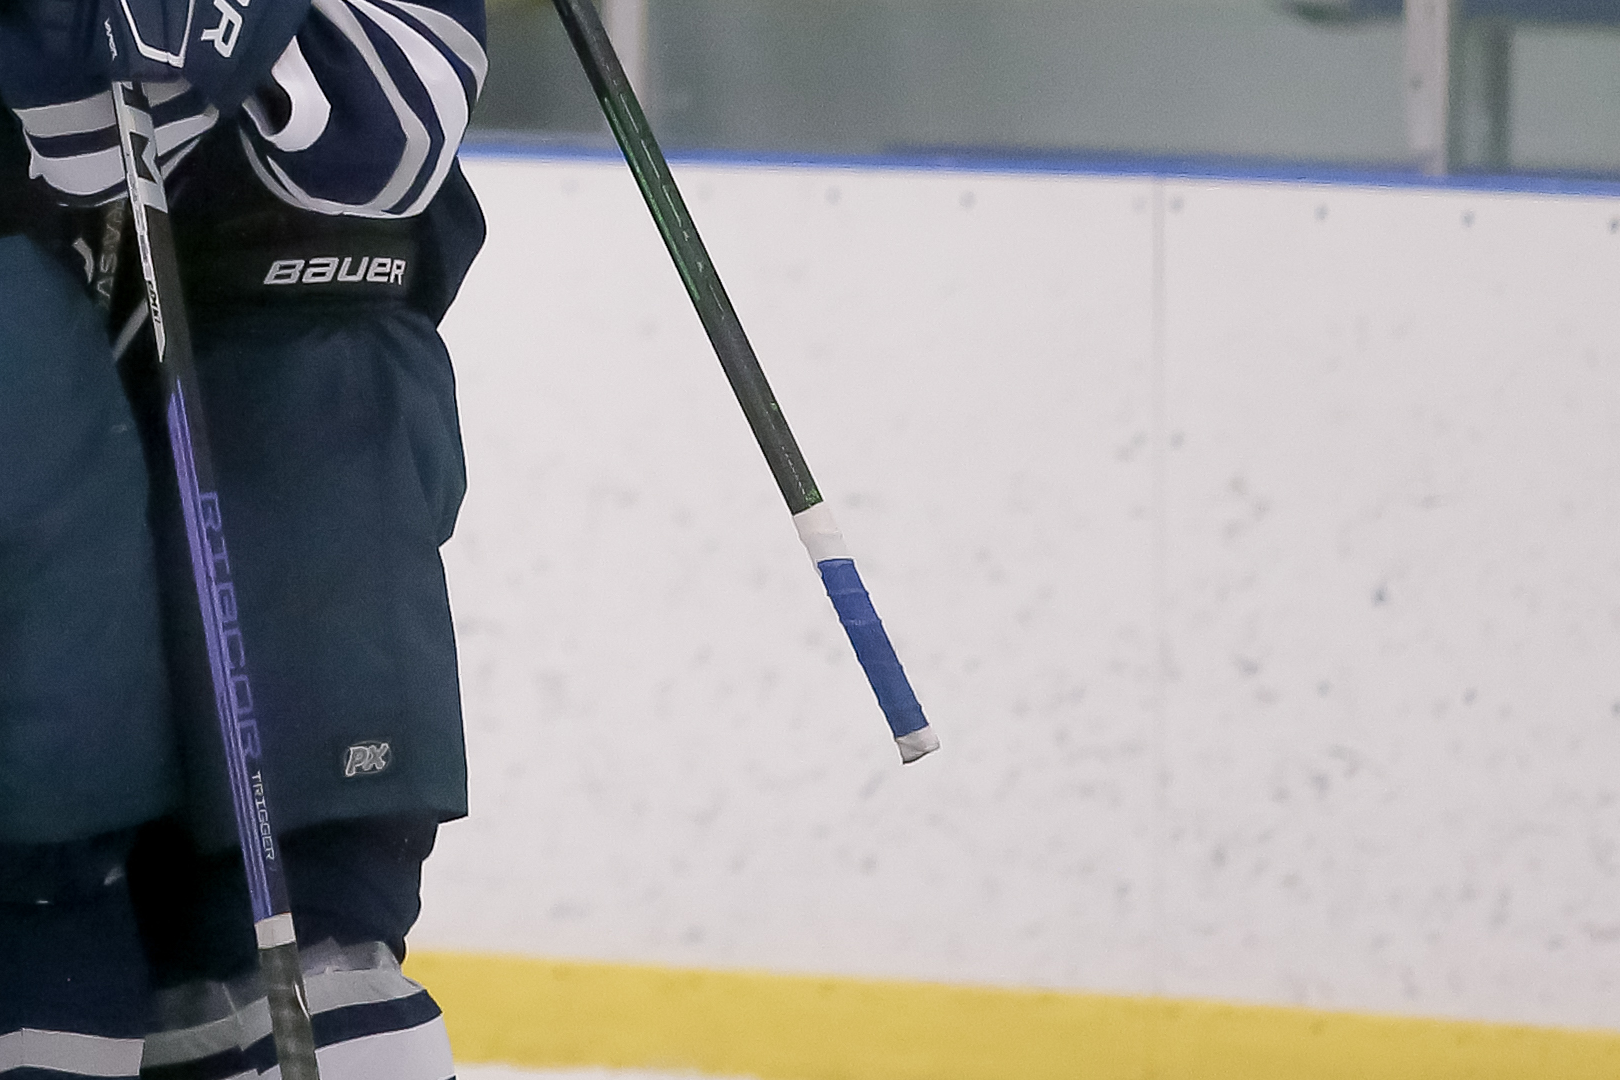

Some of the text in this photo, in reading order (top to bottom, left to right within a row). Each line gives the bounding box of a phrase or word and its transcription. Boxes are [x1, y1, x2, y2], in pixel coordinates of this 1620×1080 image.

[263, 256, 407, 286] BAUER
[345, 742, 389, 777] PX
[251, 769, 275, 861] TRIGGER
